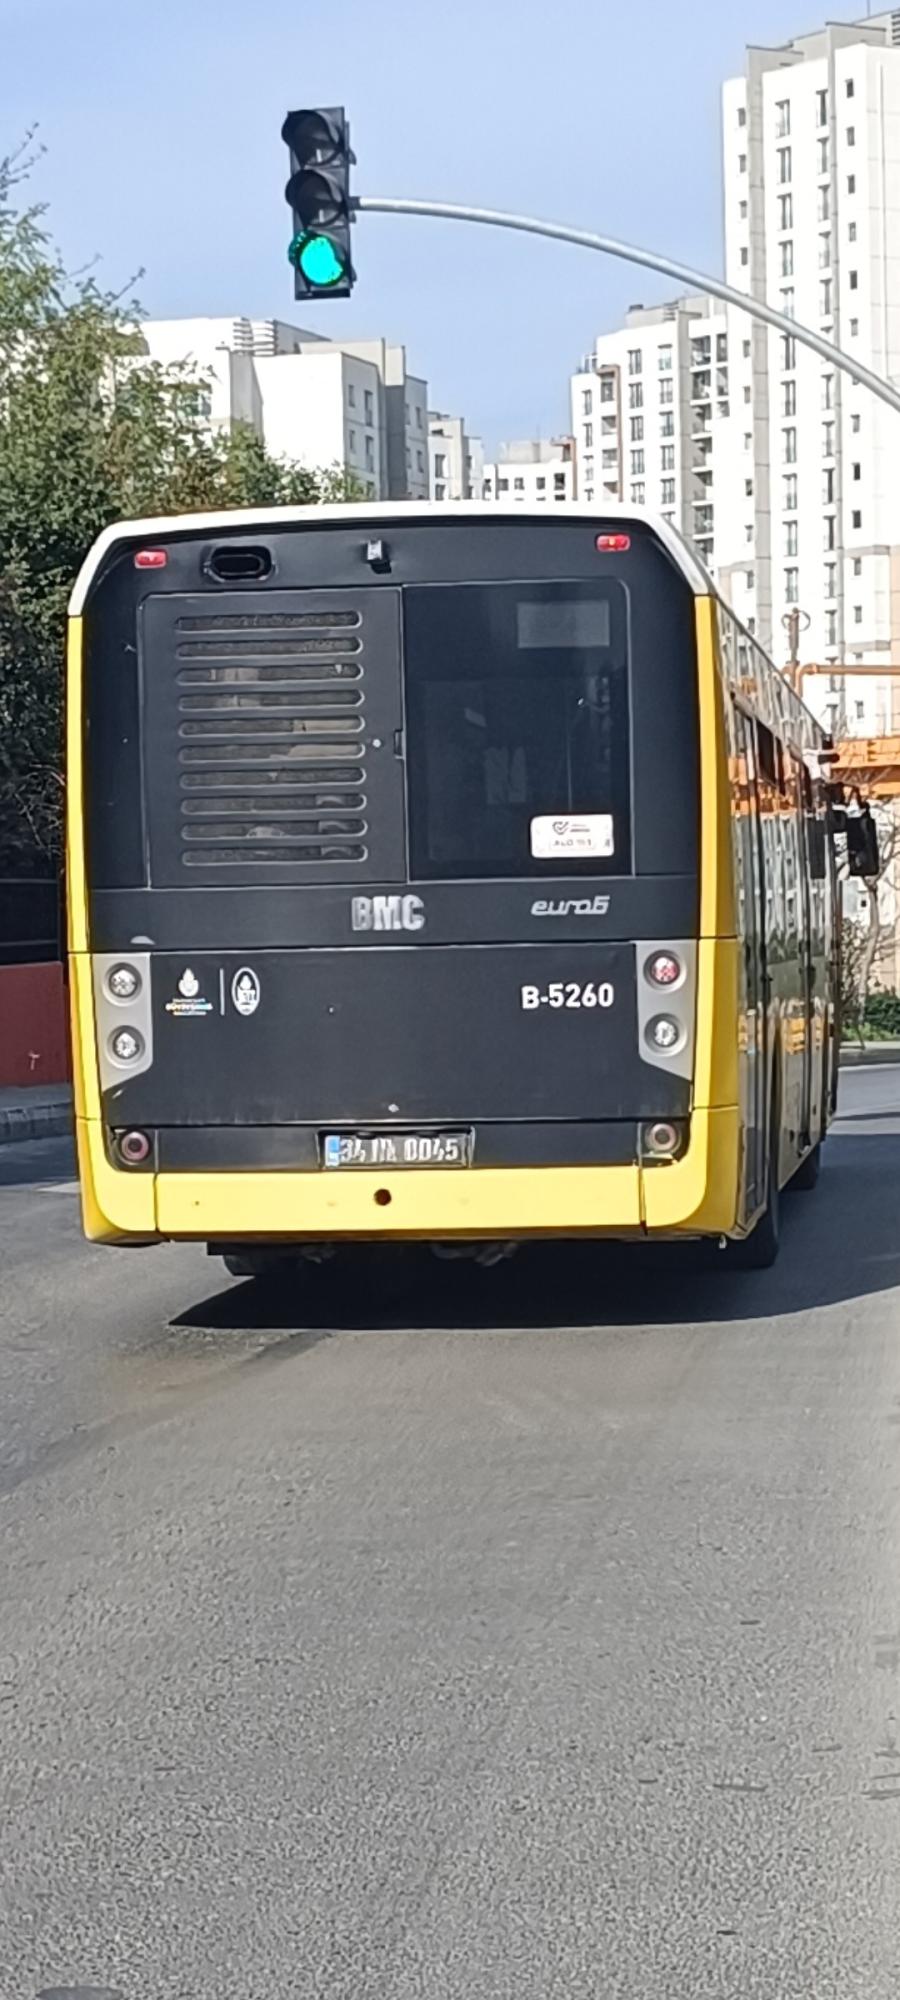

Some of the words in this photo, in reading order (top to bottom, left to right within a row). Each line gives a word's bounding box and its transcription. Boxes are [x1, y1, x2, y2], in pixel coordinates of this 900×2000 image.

[352, 895, 424, 931] BMC
[531, 896, 610, 916] euro6
[521, 983, 614, 1009] B-5260
